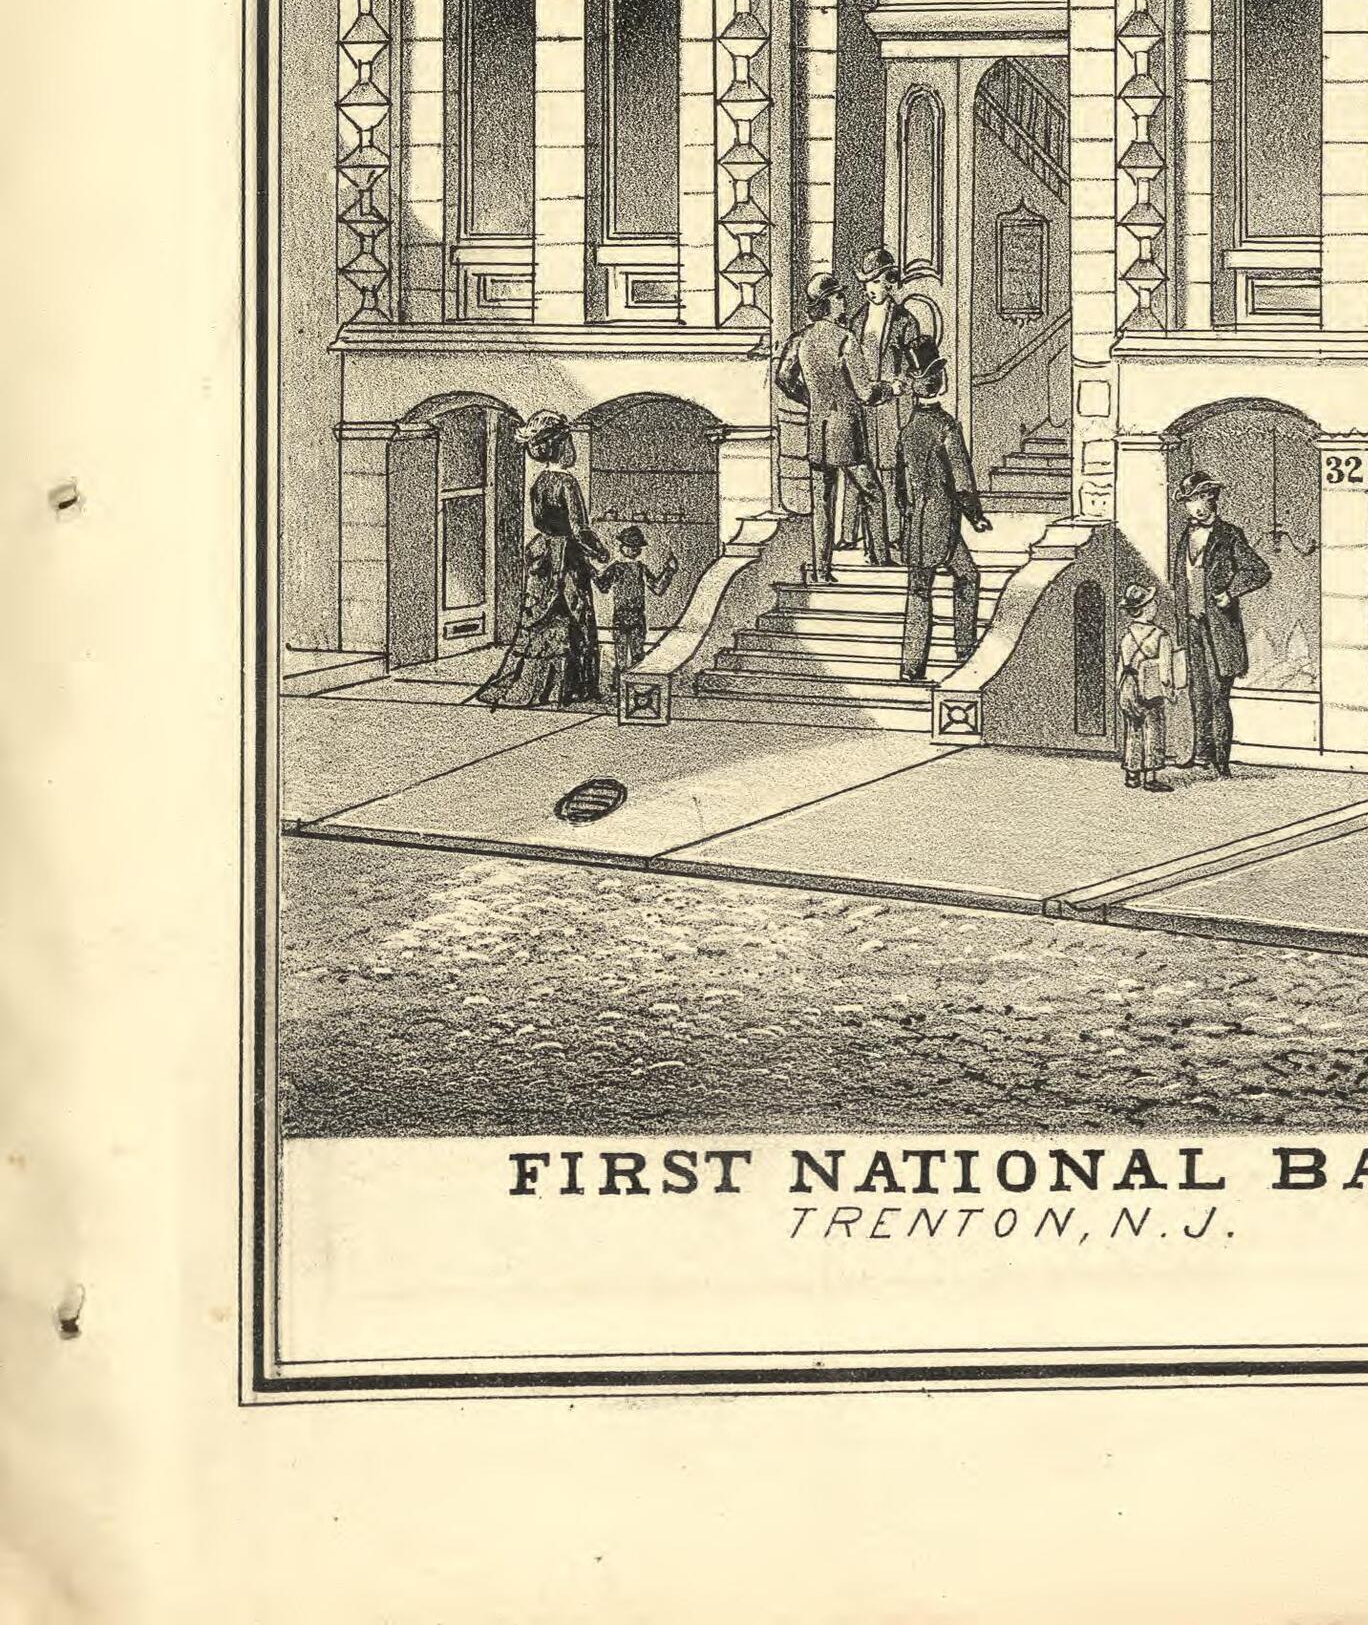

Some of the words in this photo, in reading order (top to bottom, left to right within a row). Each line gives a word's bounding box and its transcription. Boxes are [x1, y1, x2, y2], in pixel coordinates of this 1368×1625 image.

[1326, 456, 1364, 484] 32
[508, 1150, 752, 1196] FIRST
[789, 1148, 1226, 1194] NATIONAL
[791, 1206, 1089, 1246] TRENTON,
